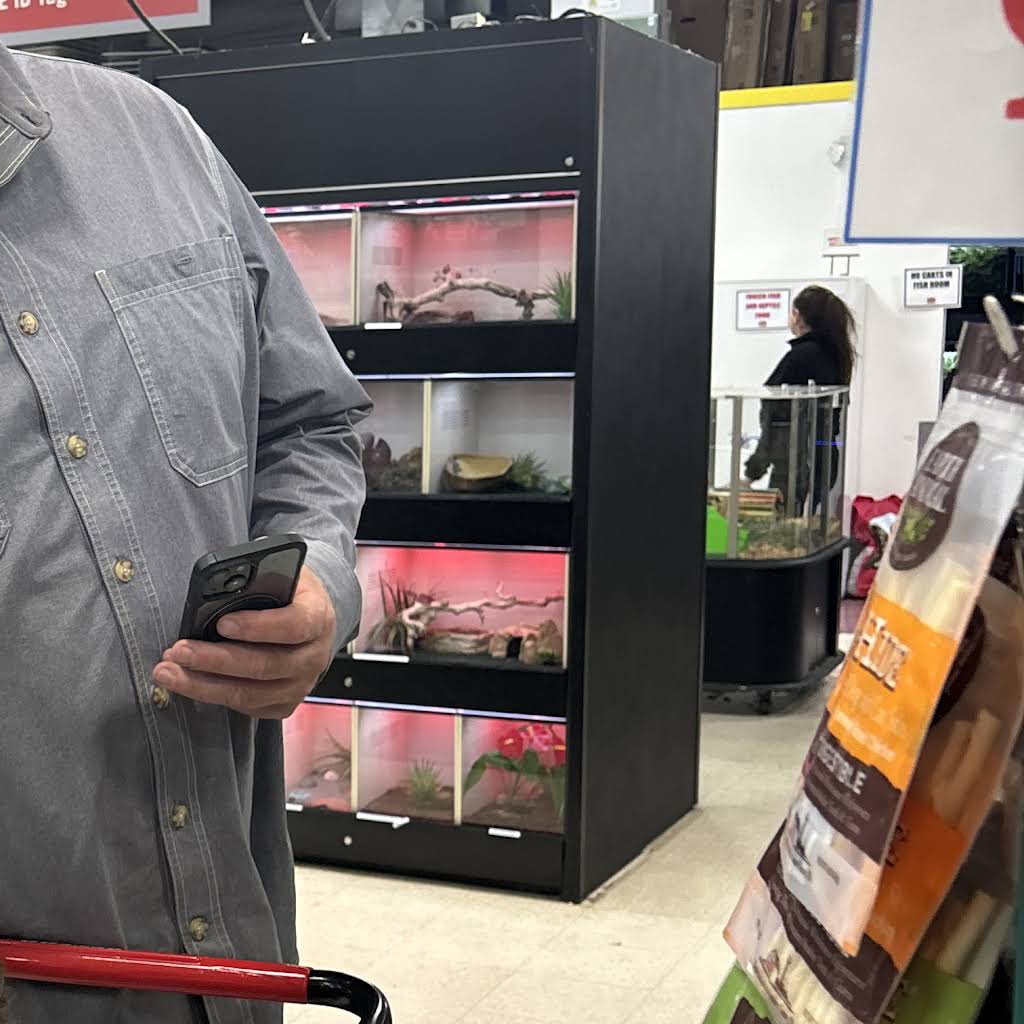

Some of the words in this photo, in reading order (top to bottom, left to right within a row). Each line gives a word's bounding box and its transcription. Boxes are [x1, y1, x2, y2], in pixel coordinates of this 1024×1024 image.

[922, 271, 944, 279] CARTS
[913, 281, 928, 289] FISH
[929, 280, 950, 288] ROOM
